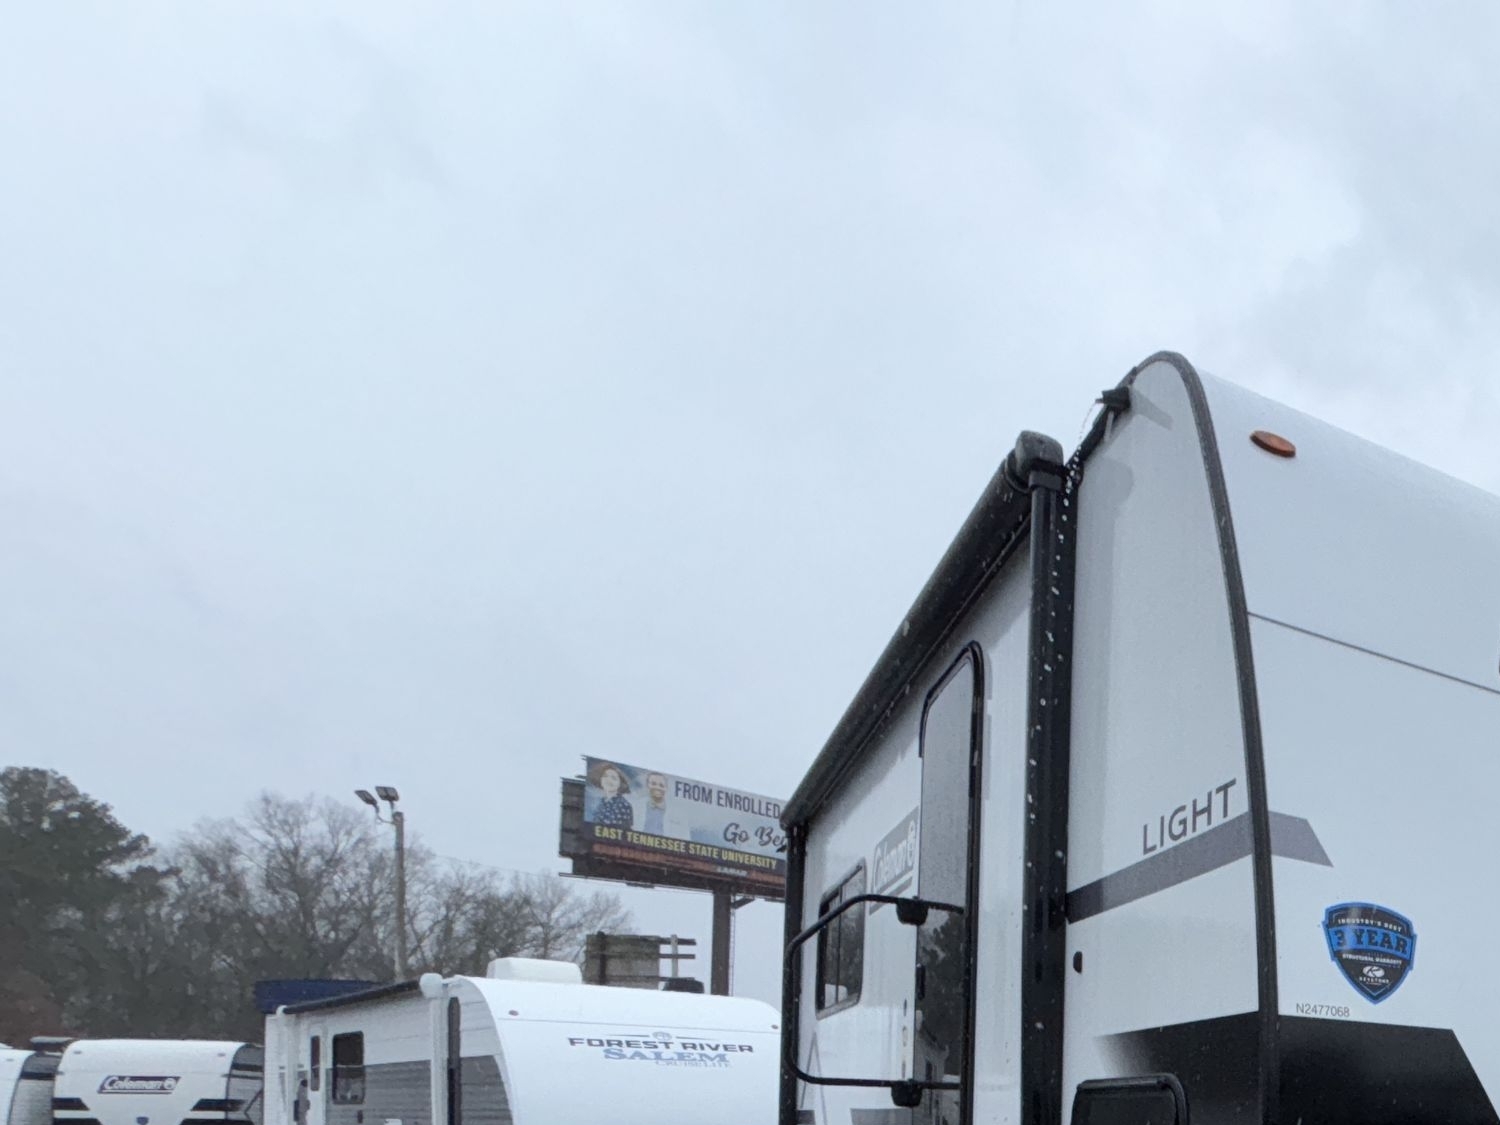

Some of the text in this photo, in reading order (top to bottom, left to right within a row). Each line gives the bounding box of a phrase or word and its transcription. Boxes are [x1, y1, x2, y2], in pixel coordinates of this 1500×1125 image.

[674, 780, 780, 819] FROM ENROLLED
[1142, 778, 1237, 855] LIGHT
[723, 822, 750, 846] Go
[595, 826, 778, 871] EAST TENNESSEE STATE UNIVERSITY
[1352, 928, 1408, 955] YEAR
[1295, 1002, 1351, 1018] N2477068
[567, 1037, 755, 1054] FOREST RIVER
[603, 1047, 730, 1063] SALEM
[103, 1076, 162, 1090] Coleman
